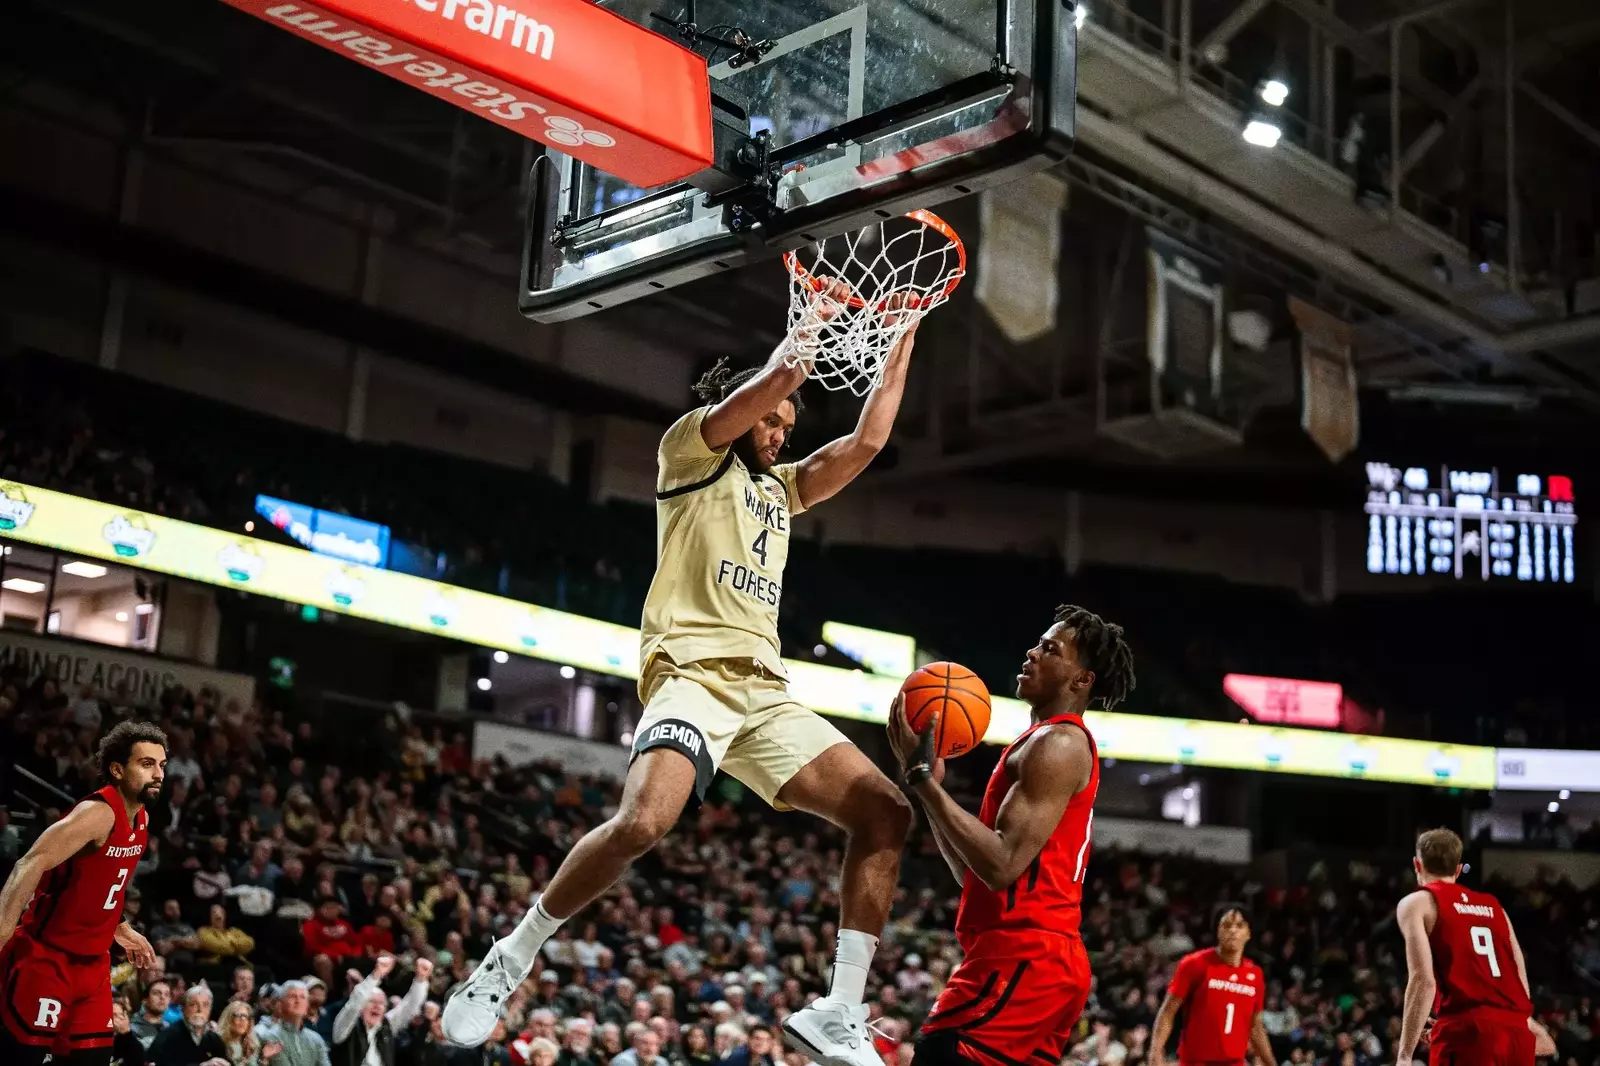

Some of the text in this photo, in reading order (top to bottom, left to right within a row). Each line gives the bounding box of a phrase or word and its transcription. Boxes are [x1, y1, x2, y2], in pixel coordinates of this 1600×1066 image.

[744, 486, 786, 531] WAKE
[752, 529, 768, 567] 4
[648, 723, 702, 757] DEMON
[105, 844, 143, 858] RUTGERS
[103, 868, 128, 910] 2
[1470, 926, 1501, 977] 9
[34, 997, 62, 1029] R
[1224, 1002, 1235, 1035] 1
